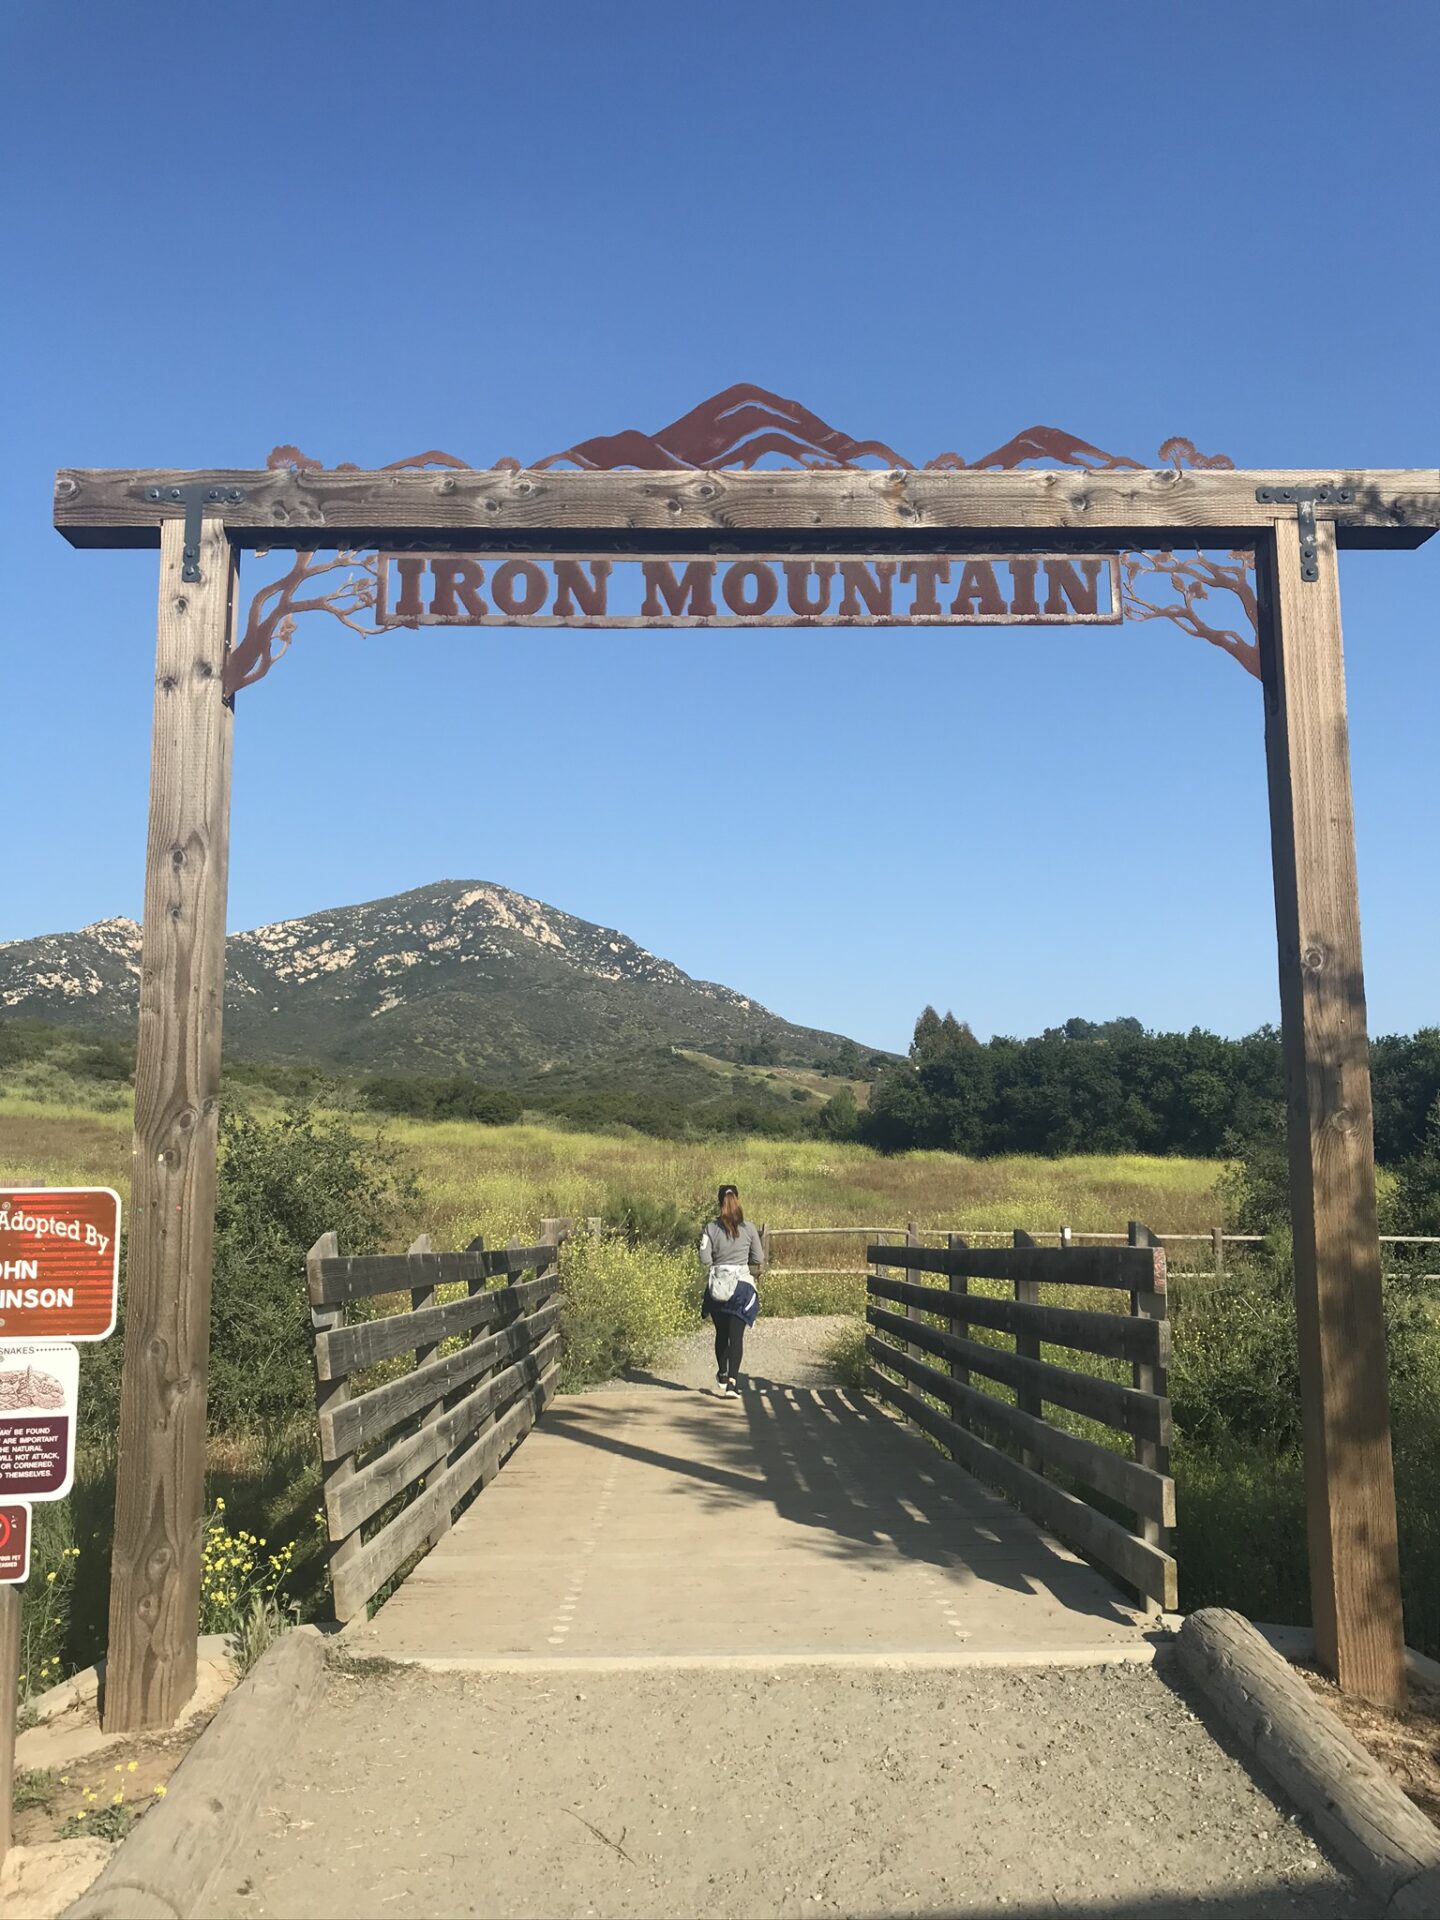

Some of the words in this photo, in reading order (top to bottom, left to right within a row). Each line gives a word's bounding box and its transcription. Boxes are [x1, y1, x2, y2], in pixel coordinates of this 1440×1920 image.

[396, 558, 612, 616] IRON
[641, 559, 1101, 616] MOUNTAIN
[0, 1210, 80, 1241] Adopted
[85, 1223, 110, 1256] By
[0, 1260, 37, 1280] HN
[12, 1445, 43, 1453] NATURAL
[15, 1453, 30, 1461] NOT
